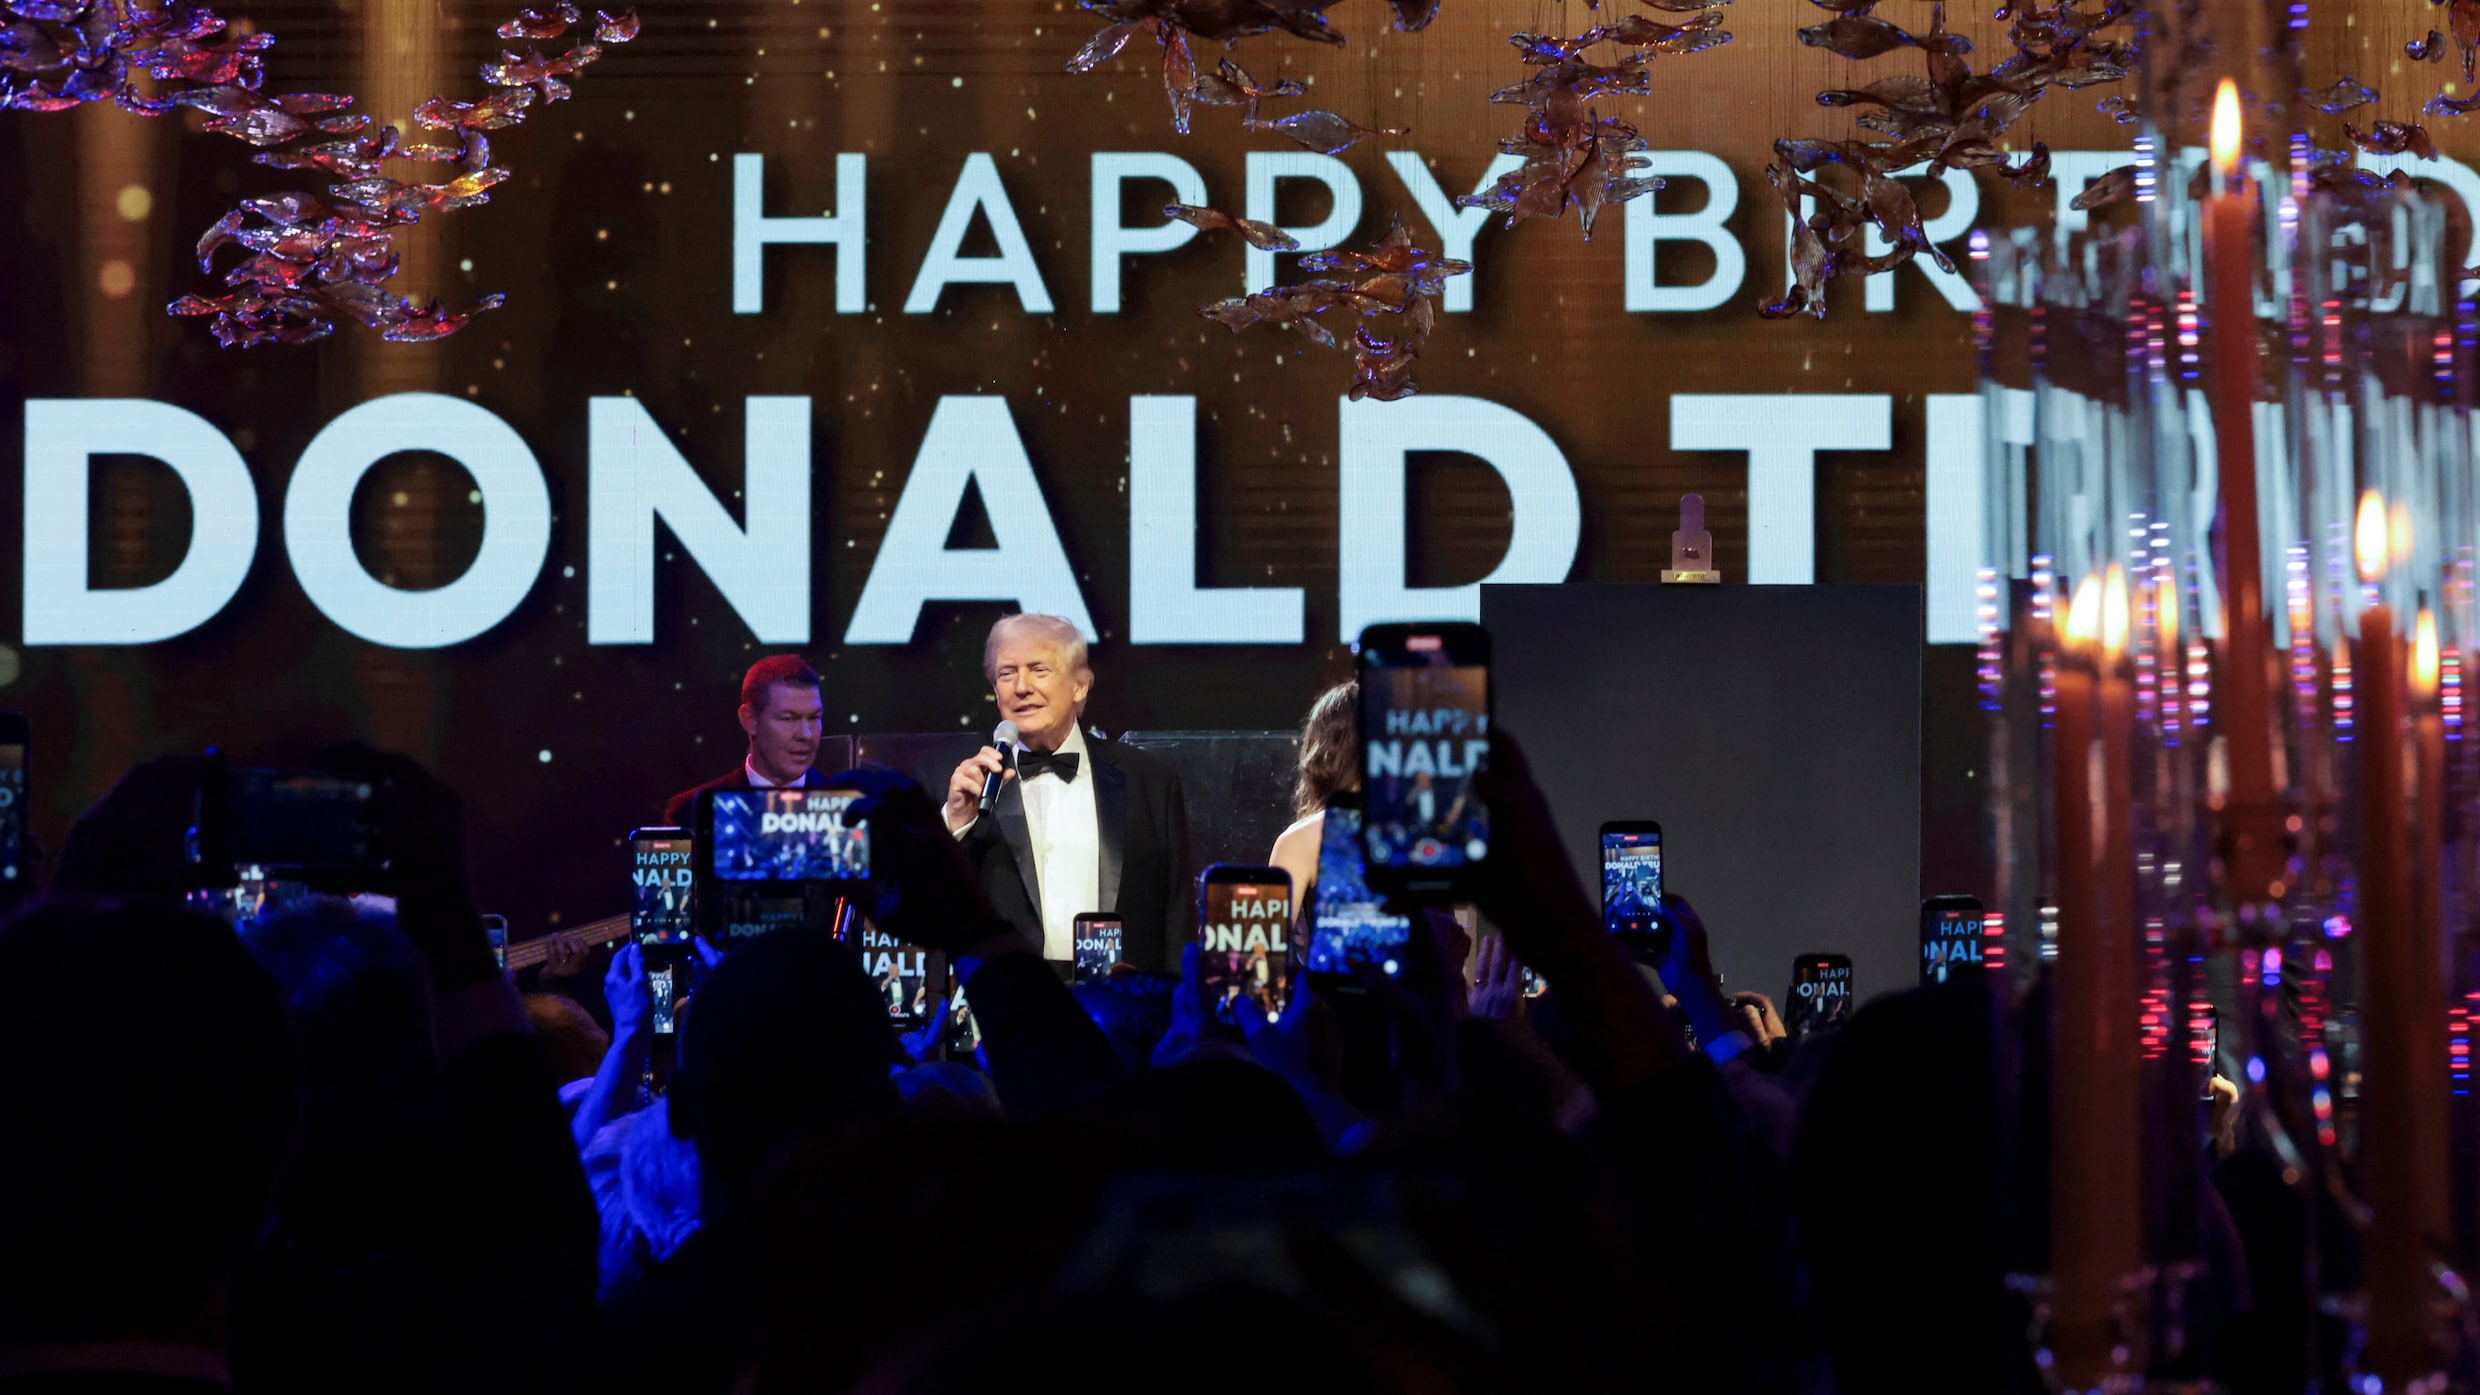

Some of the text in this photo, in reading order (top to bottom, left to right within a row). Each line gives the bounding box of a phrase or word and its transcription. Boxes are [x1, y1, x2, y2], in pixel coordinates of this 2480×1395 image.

[732, 152, 1530, 314] HAPPY
[23, 392, 1581, 648] DONALD
[636, 852, 691, 865] HAPPY
[762, 813, 867, 833] DONAL
